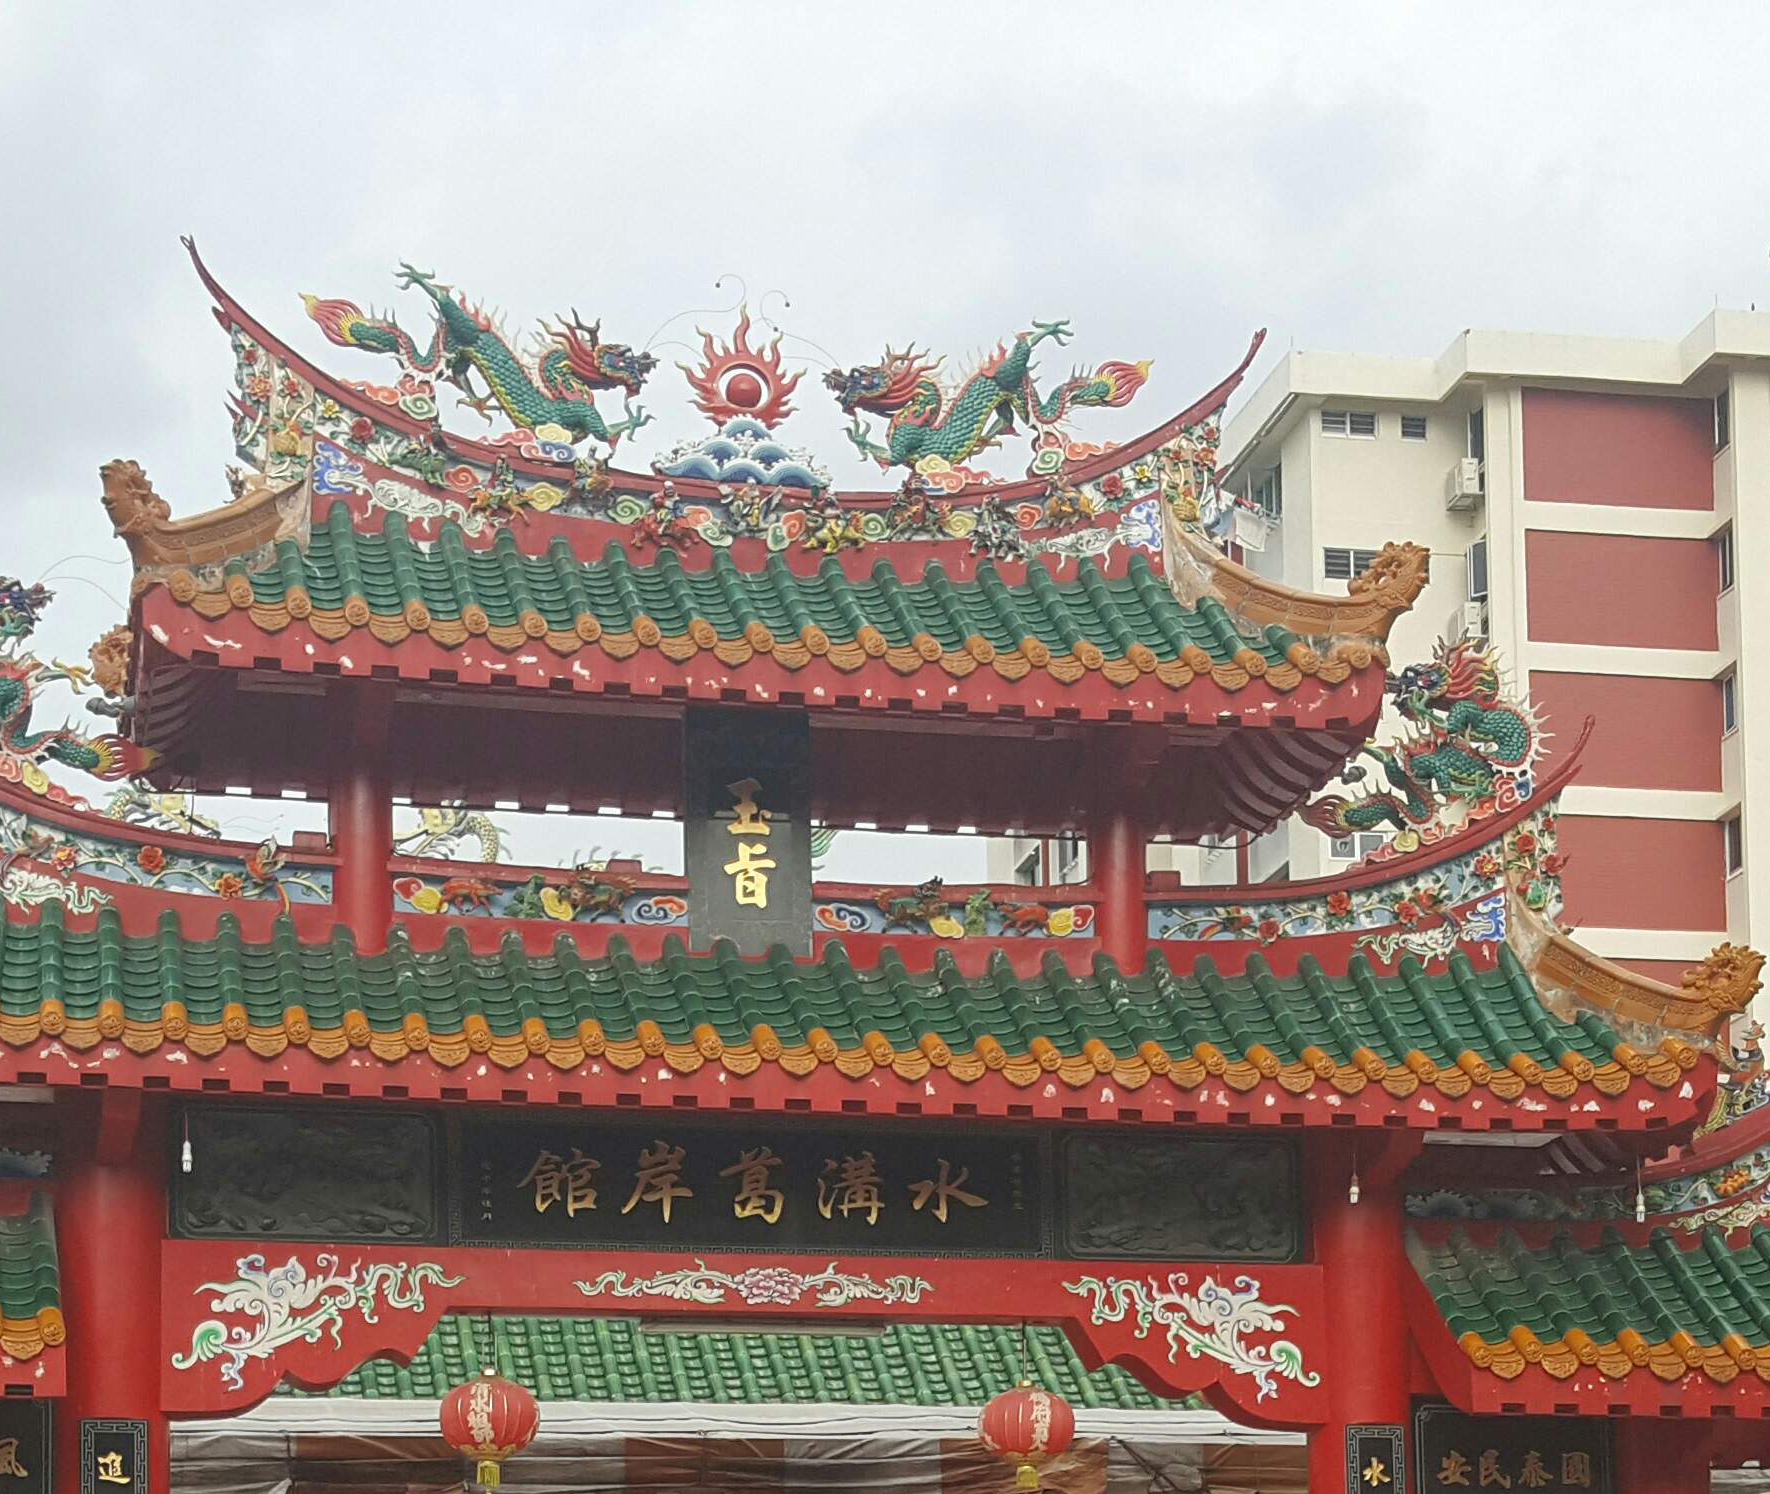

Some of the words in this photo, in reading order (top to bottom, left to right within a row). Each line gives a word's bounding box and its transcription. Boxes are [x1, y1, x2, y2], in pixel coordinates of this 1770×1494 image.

[724, 777, 777, 909] 玉旨
[516, 1140, 989, 1227] 水溝葛岸館
[1436, 1449, 1591, 1489] 國泰民安
